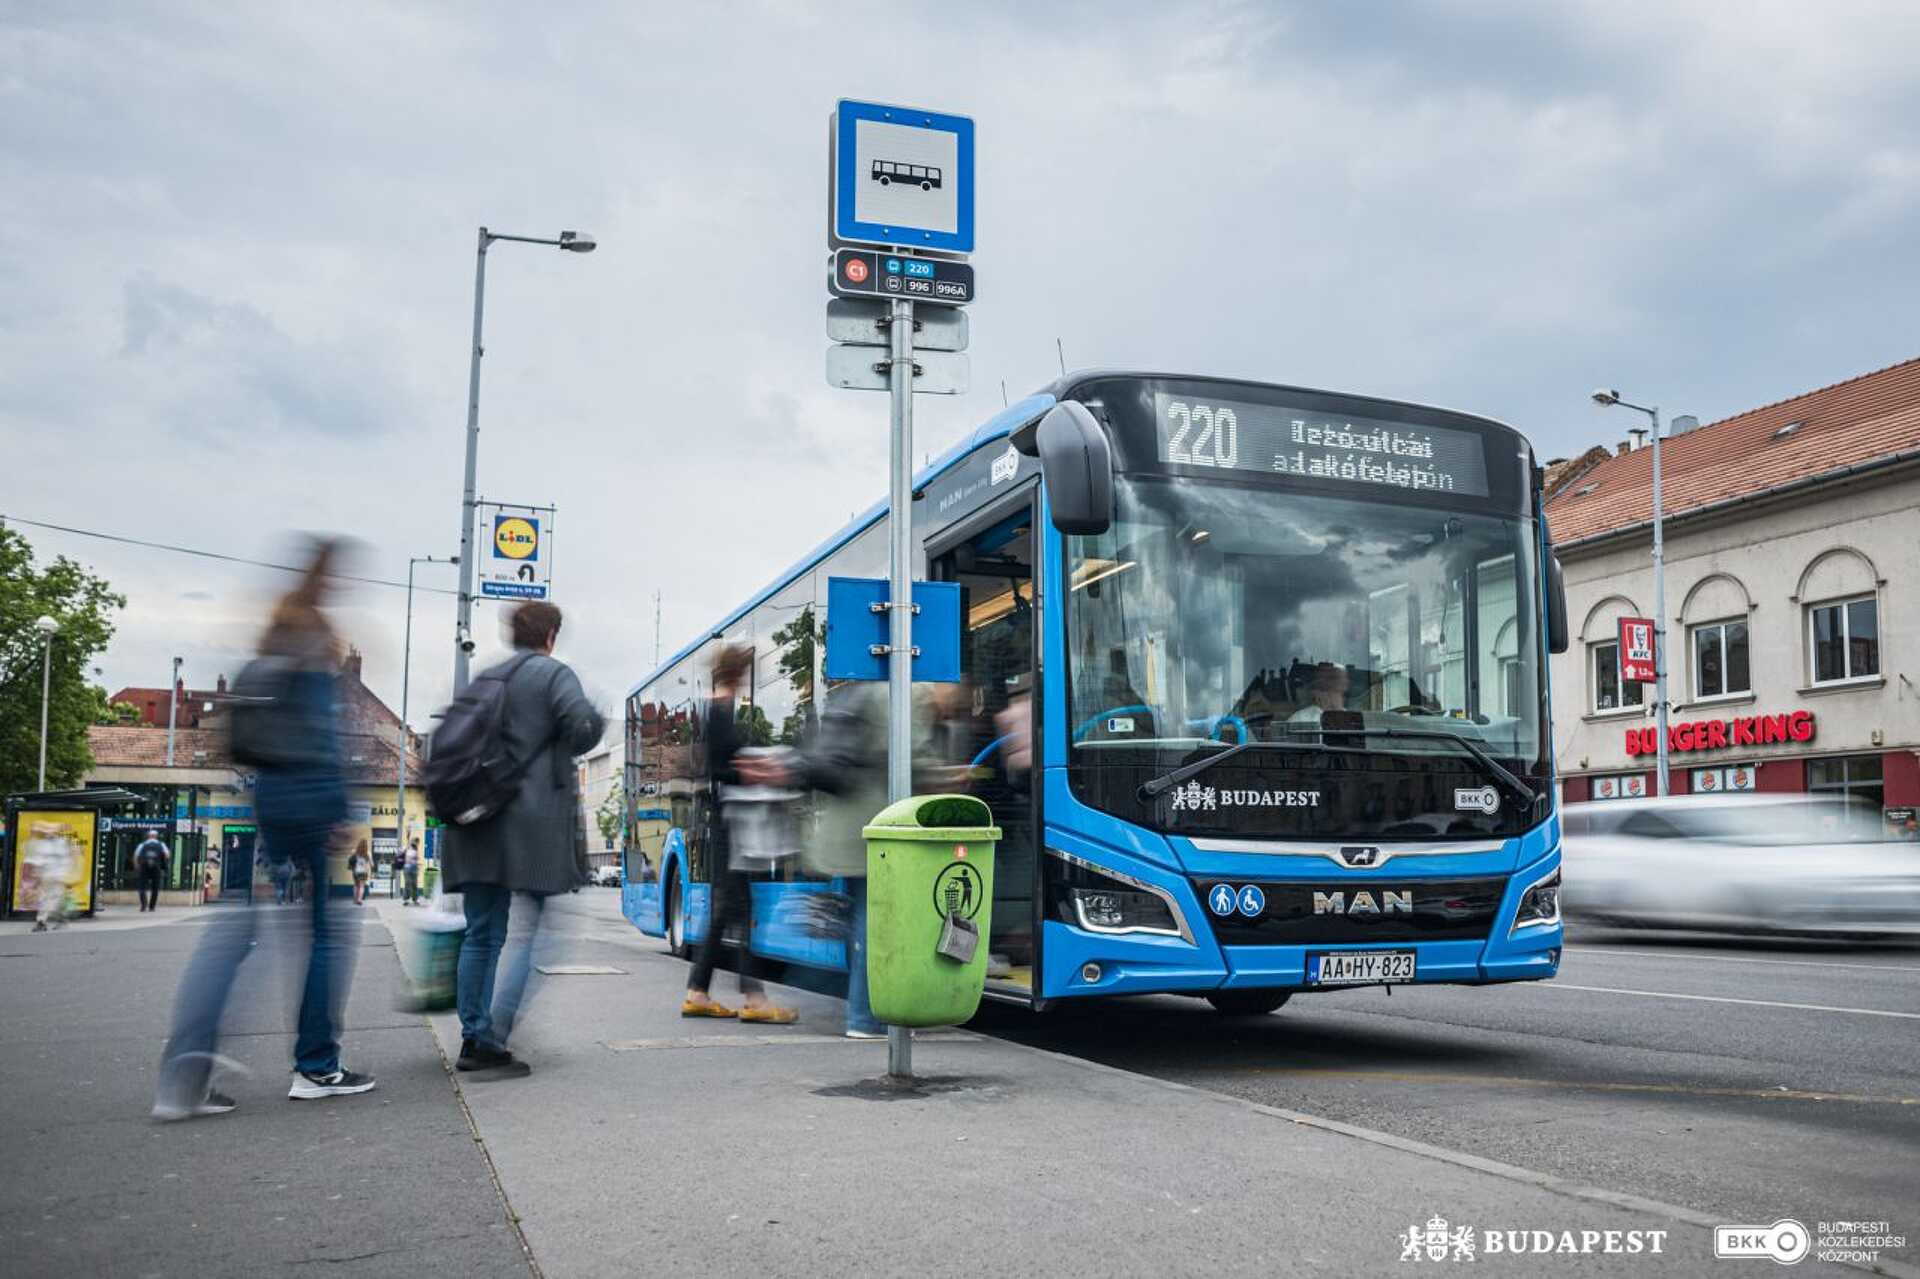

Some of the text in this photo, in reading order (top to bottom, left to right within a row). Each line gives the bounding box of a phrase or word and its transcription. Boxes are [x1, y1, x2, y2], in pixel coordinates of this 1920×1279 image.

[849, 265, 864, 277] C1
[909, 263, 930, 274] 220
[909, 281, 966, 296] 996 996A
[1167, 402, 1237, 468] 220
[1733, 710, 1814, 746] KING
[1220, 789, 1321, 806] BUDAPEST
[1460, 794, 1480, 804] BKK
[1313, 891, 1413, 914] MAN
